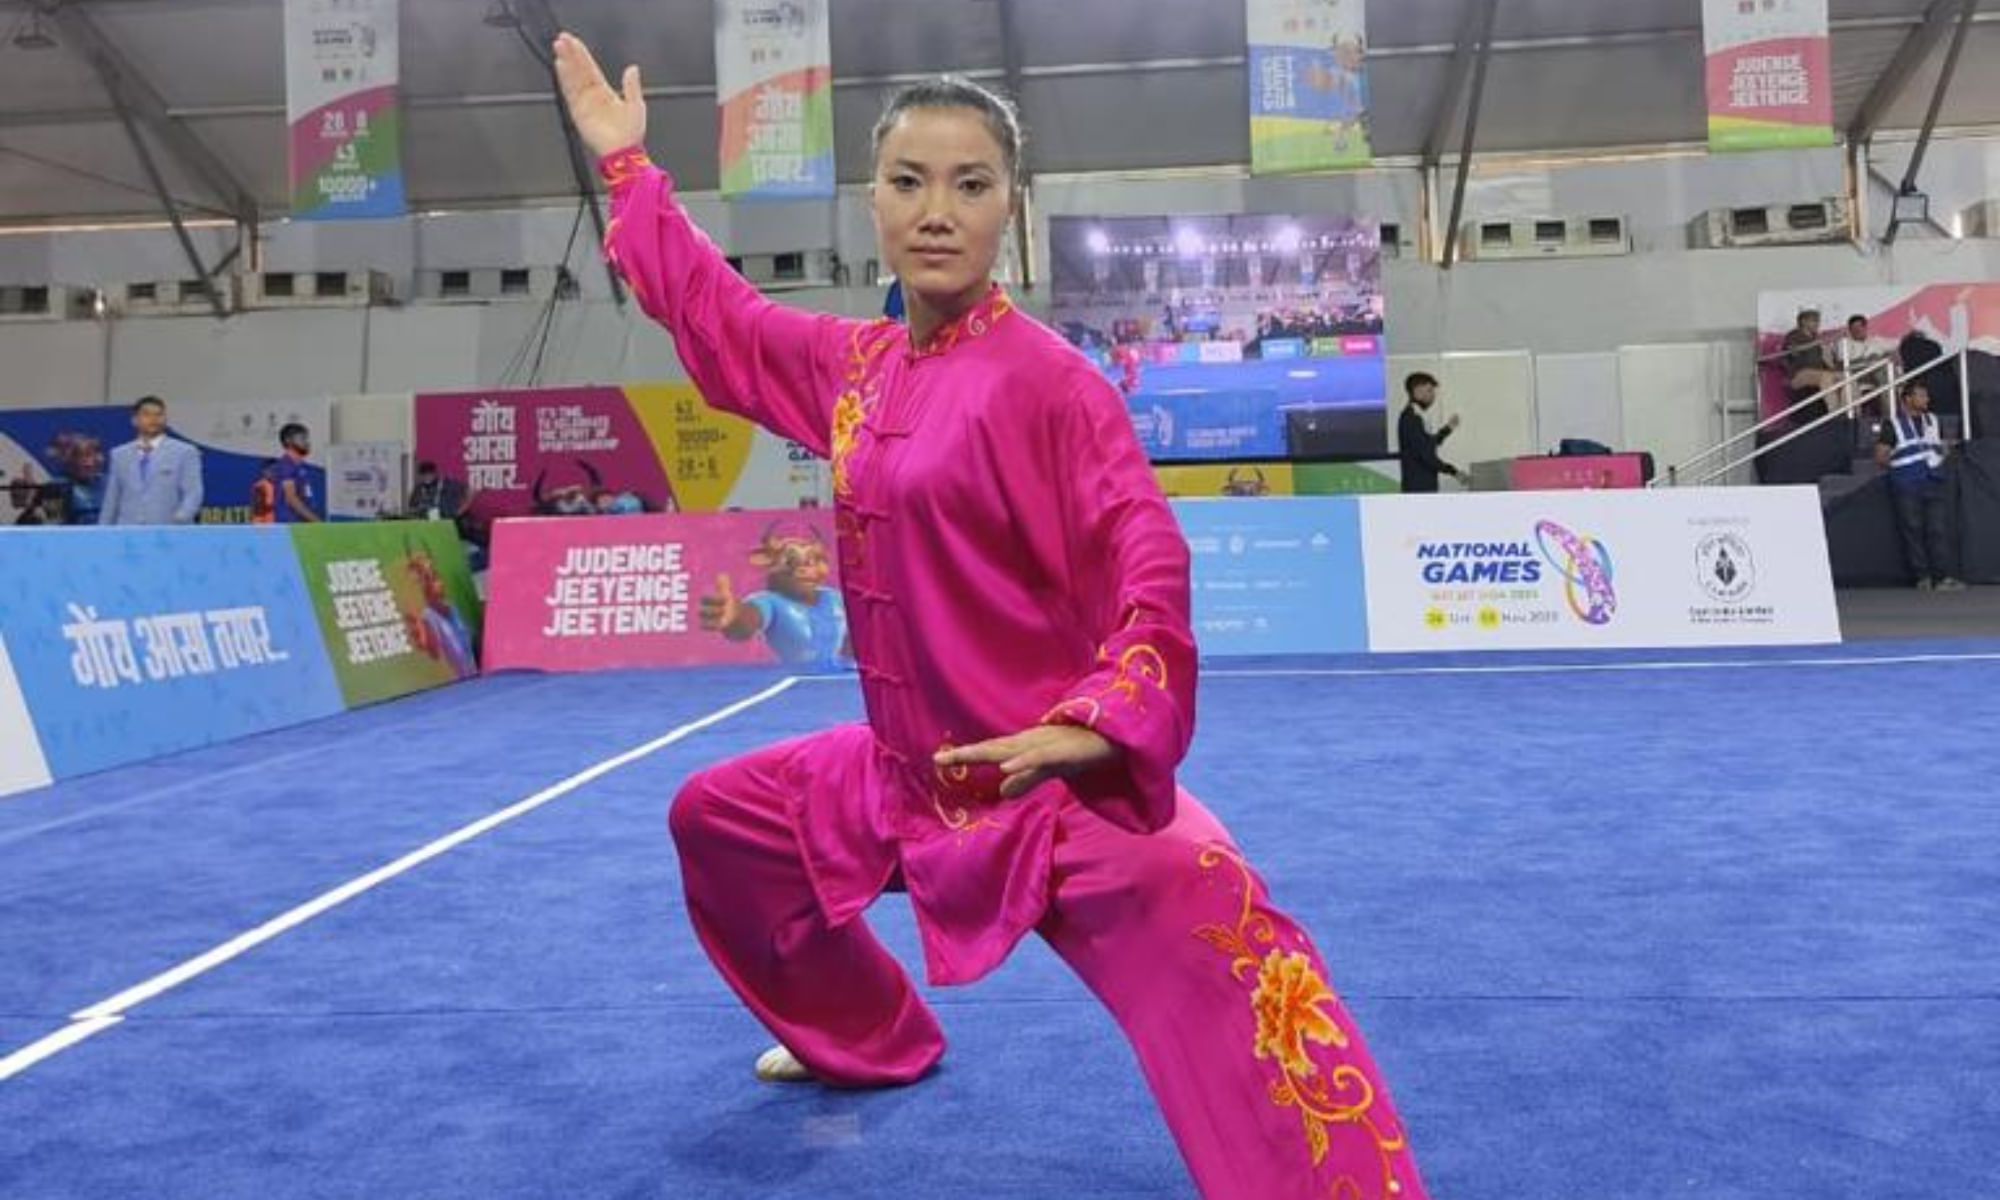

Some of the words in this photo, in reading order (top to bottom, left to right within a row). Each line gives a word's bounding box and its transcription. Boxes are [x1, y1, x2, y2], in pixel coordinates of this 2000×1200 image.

[556, 543, 683, 575] JUDENGE
[1417, 542, 1533, 559] NATIONAL
[1422, 560, 1541, 584] GAMES
[545, 572, 690, 606] JEEYENGE
[543, 602, 688, 636] JEETENGE
[62, 602, 142, 688] गोंय
[134, 611, 216, 680] आसा
